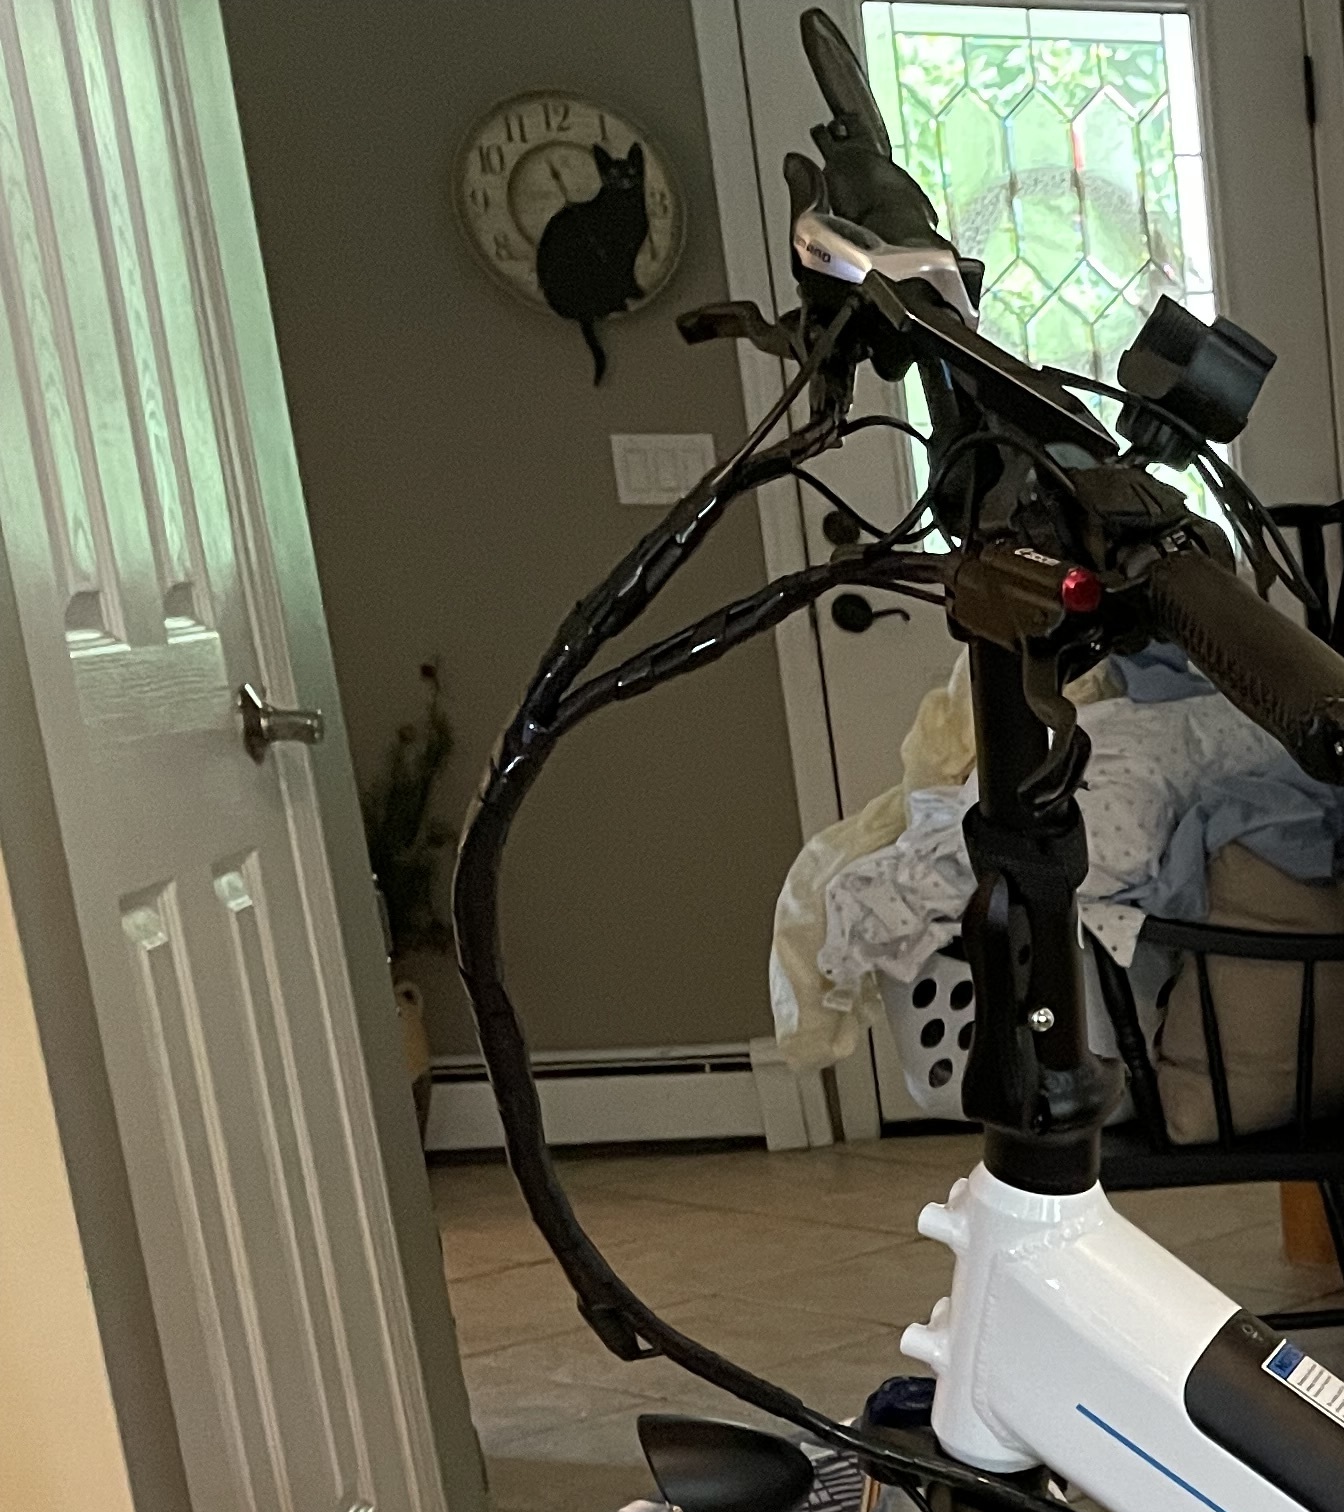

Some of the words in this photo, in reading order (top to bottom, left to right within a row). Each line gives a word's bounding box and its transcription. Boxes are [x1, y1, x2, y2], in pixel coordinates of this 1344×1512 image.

[504, 113, 528, 143] 11
[543, 102, 571, 132] 12
[479, 144, 505, 175] 10
